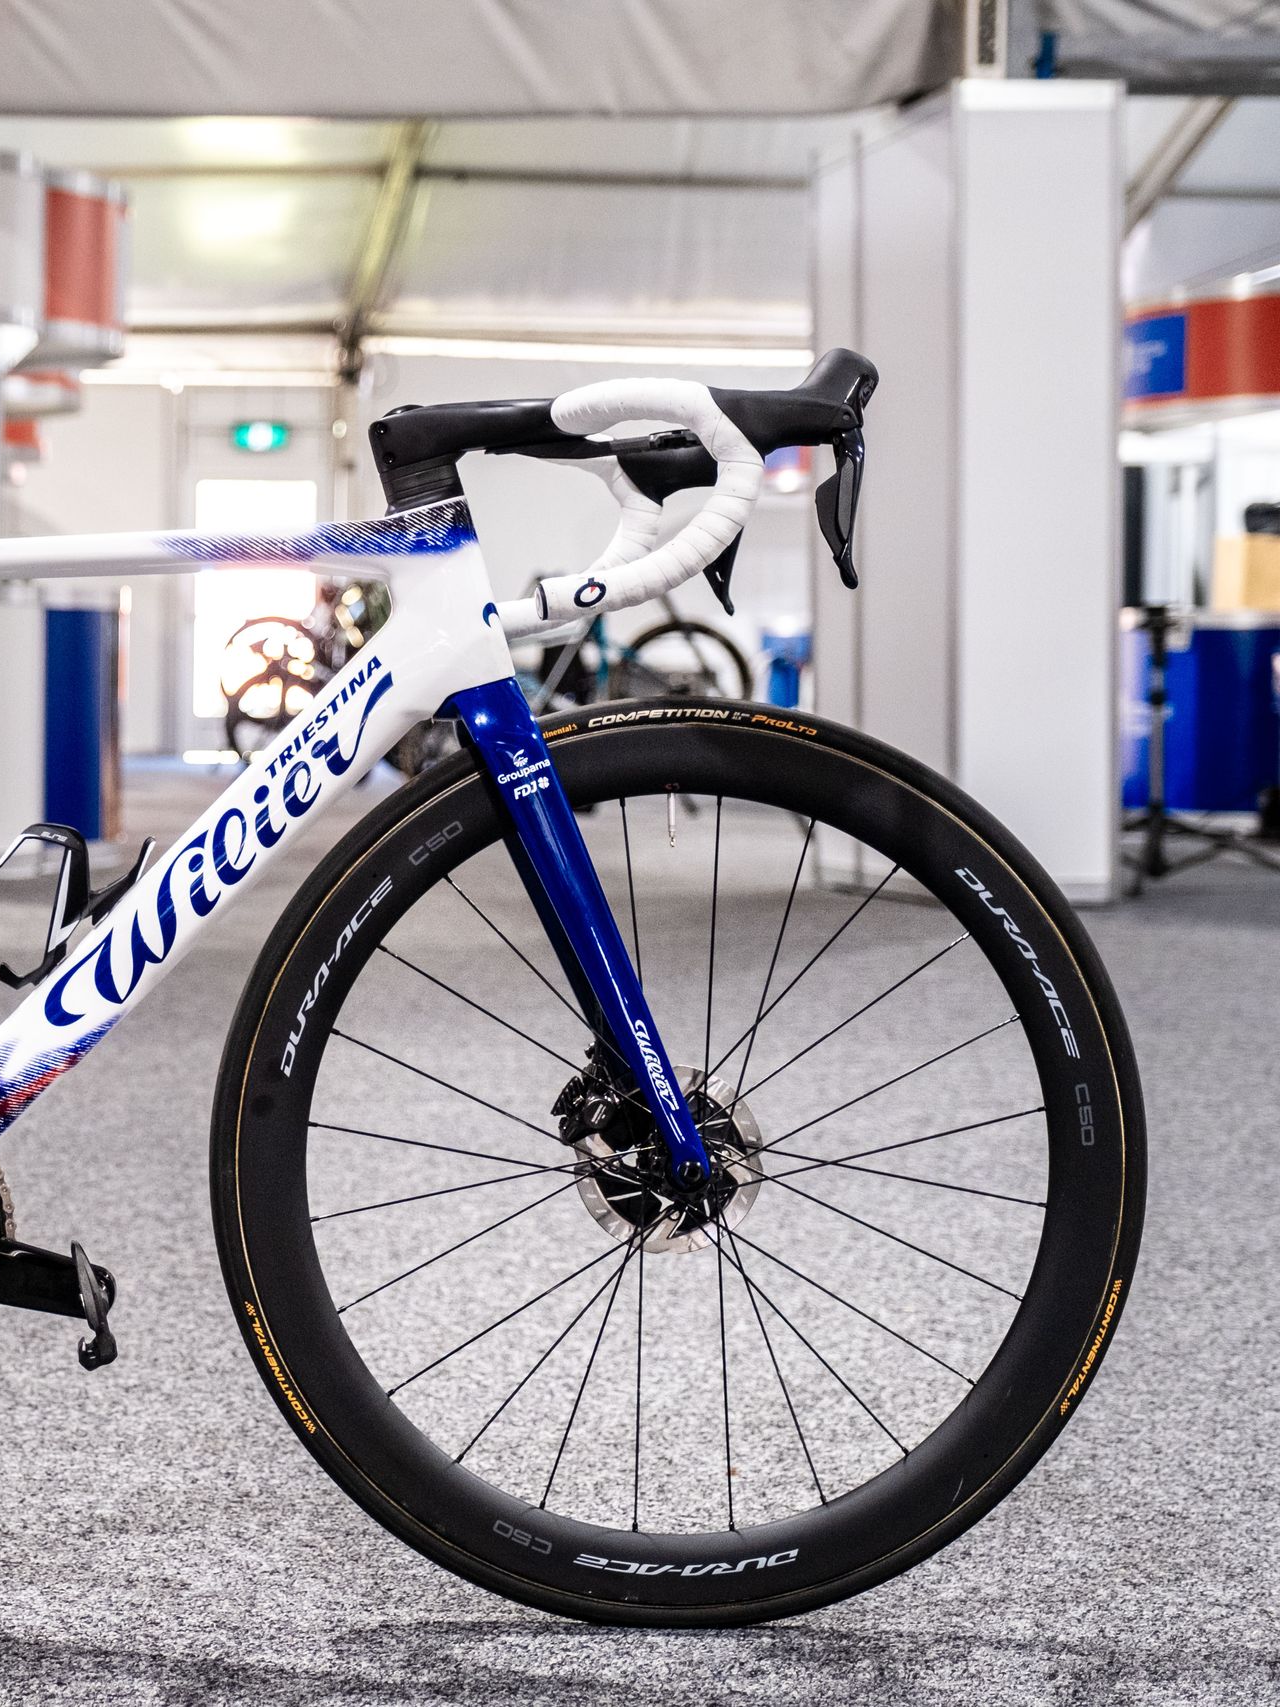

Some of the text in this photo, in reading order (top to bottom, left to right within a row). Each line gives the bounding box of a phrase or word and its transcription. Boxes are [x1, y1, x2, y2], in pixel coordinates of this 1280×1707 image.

[264, 655, 383, 780] TRIESTINA
[497, 758, 551, 784] Groupama
[542, 724, 572, 739] tinental
[587, 708, 730, 728] COMPETITION
[513, 780, 538, 800] FDJ
[44, 671, 394, 1027] Wilier
[280, 820, 463, 1078] DURA-ACE C50
[953, 866, 1095, 1146] DURA-ACE C50
[634, 1019, 677, 1112] Wilier
[251, 1314, 308, 1421] CONTINENTAL
[1068, 1291, 1118, 1398] CONTINENTAL
[492, 1519, 799, 1577] DURA-ACE C50
